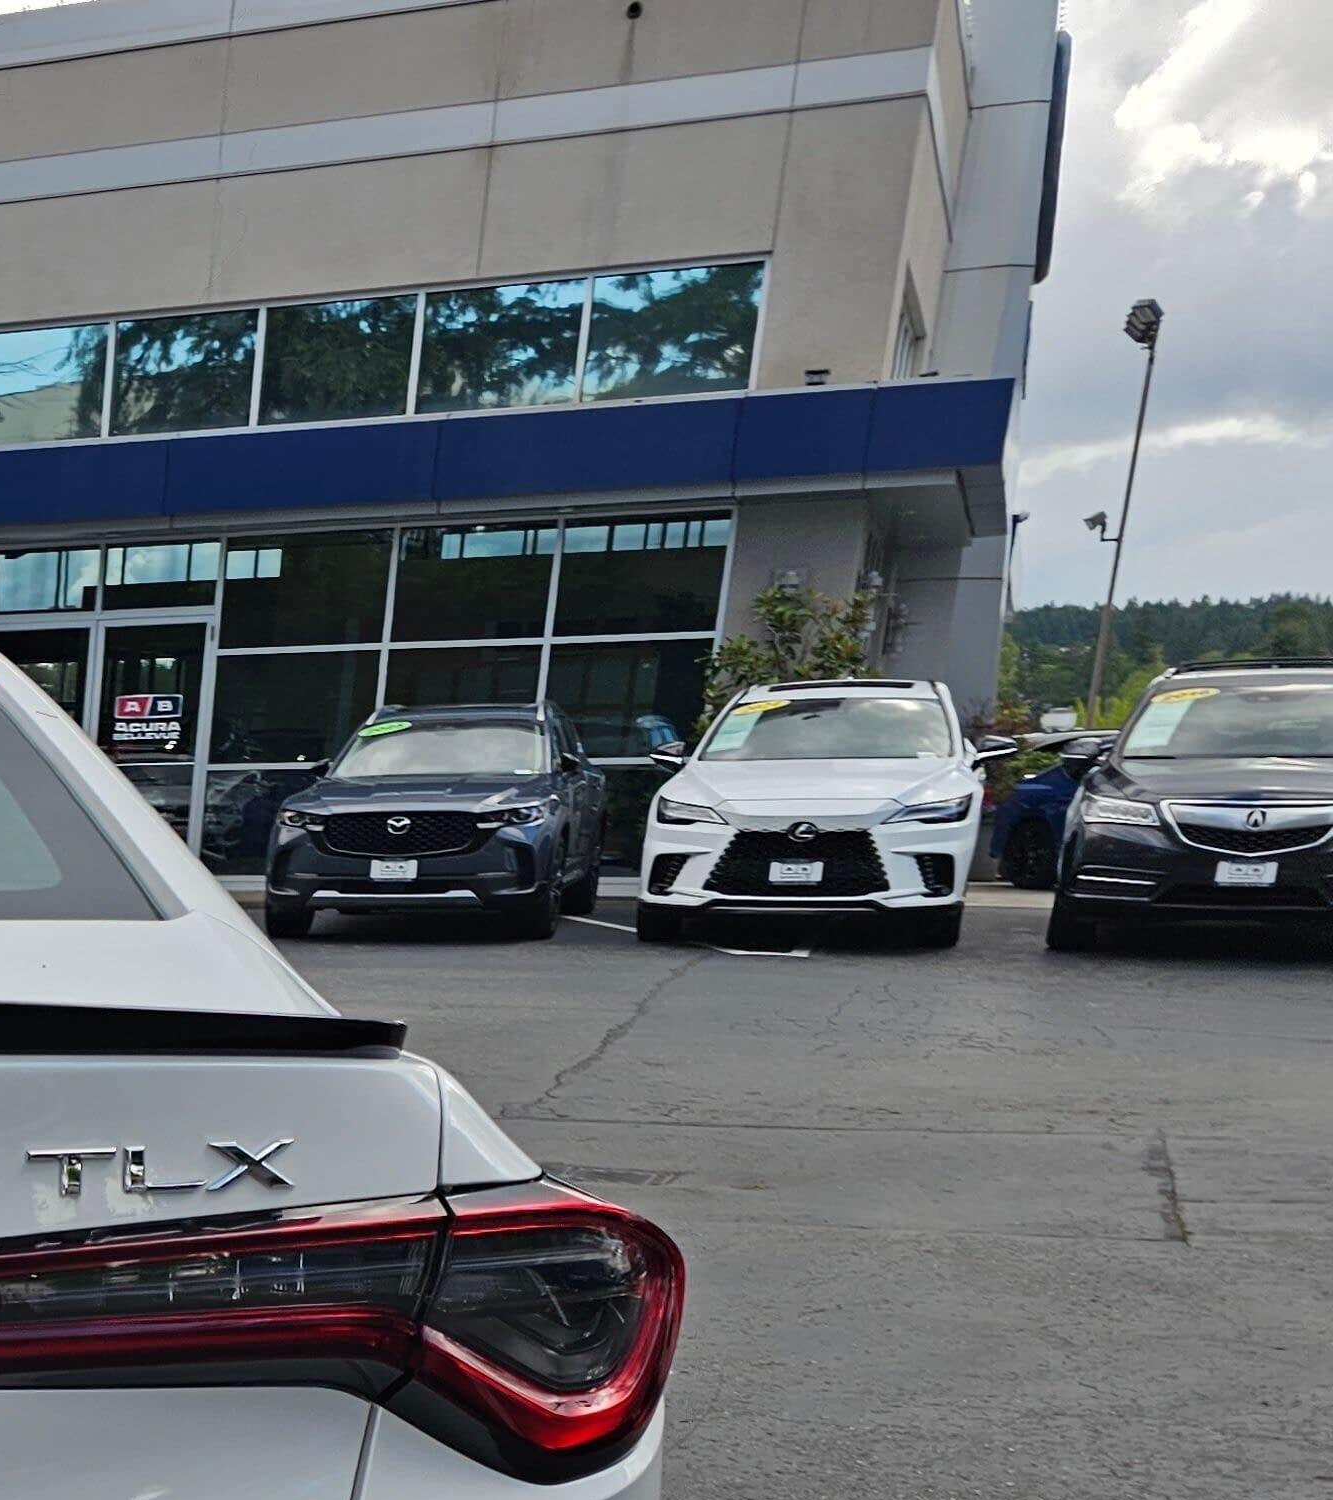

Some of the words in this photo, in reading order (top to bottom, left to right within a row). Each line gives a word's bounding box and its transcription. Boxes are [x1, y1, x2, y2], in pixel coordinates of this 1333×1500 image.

[124, 701, 141, 713] A
[157, 700, 174, 712] B
[114, 721, 181, 732] ACURA
[26, 1138, 295, 1197] TLX
